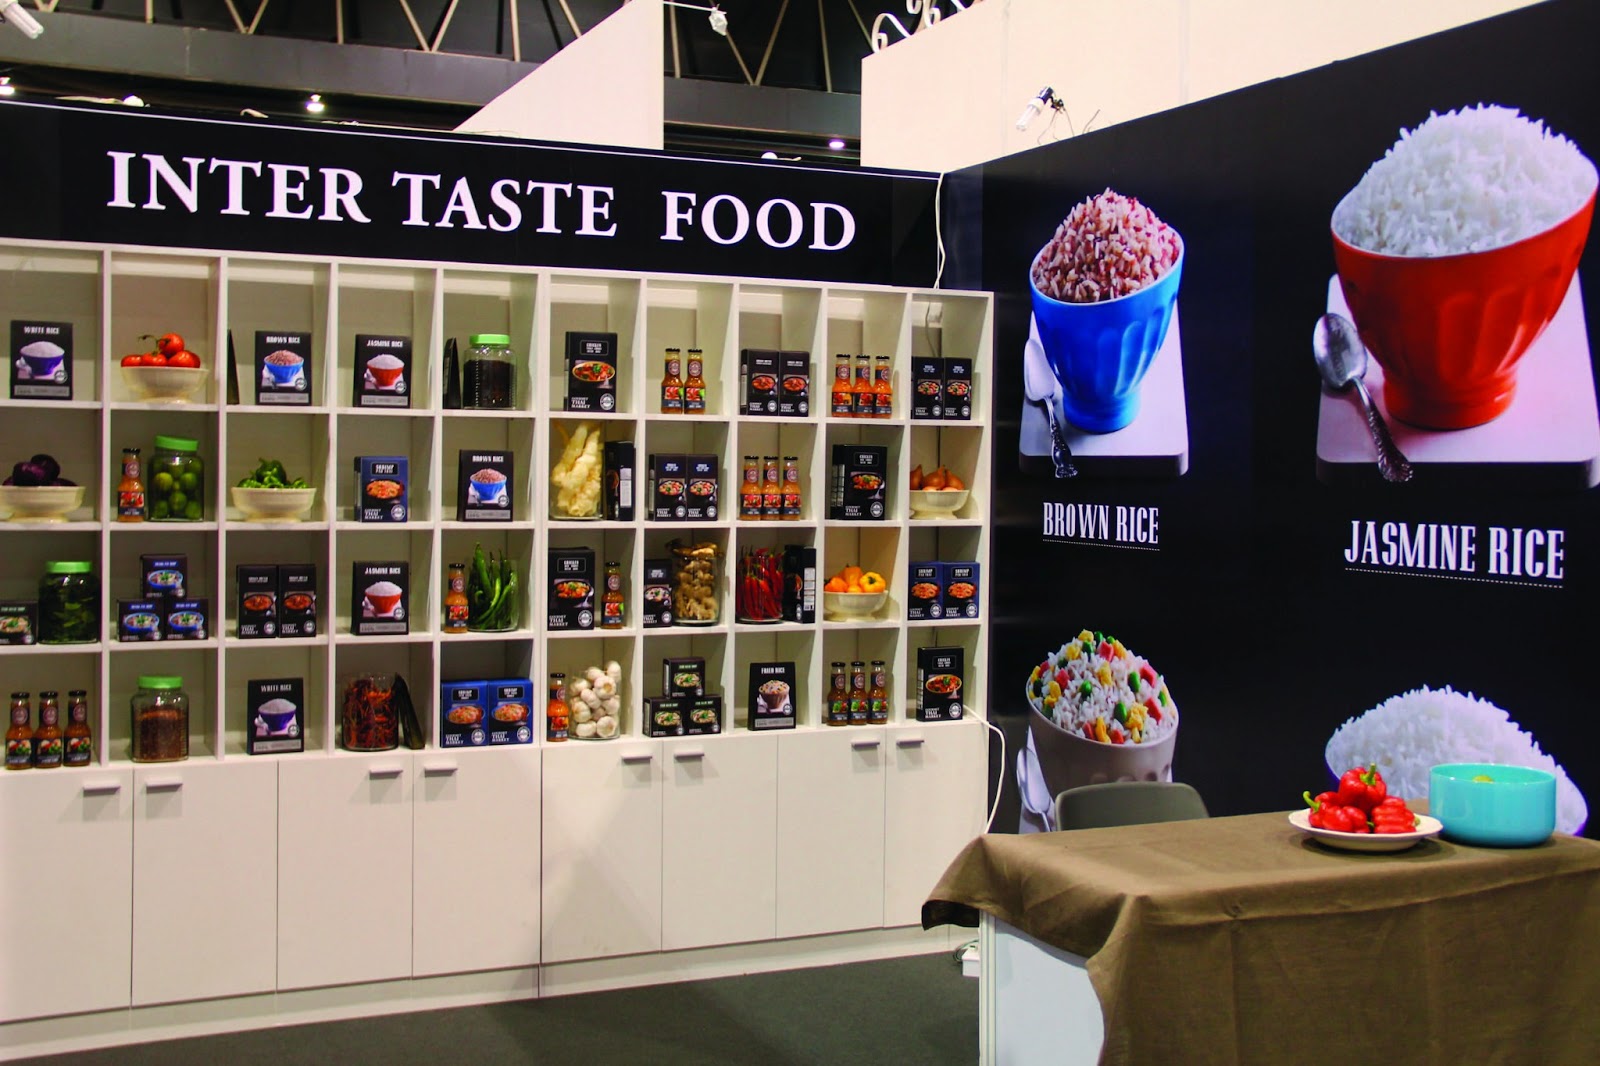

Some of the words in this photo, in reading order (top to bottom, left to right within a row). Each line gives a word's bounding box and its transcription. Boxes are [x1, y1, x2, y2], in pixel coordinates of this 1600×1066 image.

[107, 151, 371, 223] INTER
[392, 171, 617, 236] TASTE
[661, 191, 855, 250] FOOD
[46, 327, 60, 335] RICE
[1043, 502, 1109, 540] BROWN
[1116, 506, 1159, 544] RICE
[389, 567, 401, 575] RICE
[1344, 521, 1476, 572] JASMINE
[1488, 527, 1564, 579] RICE
